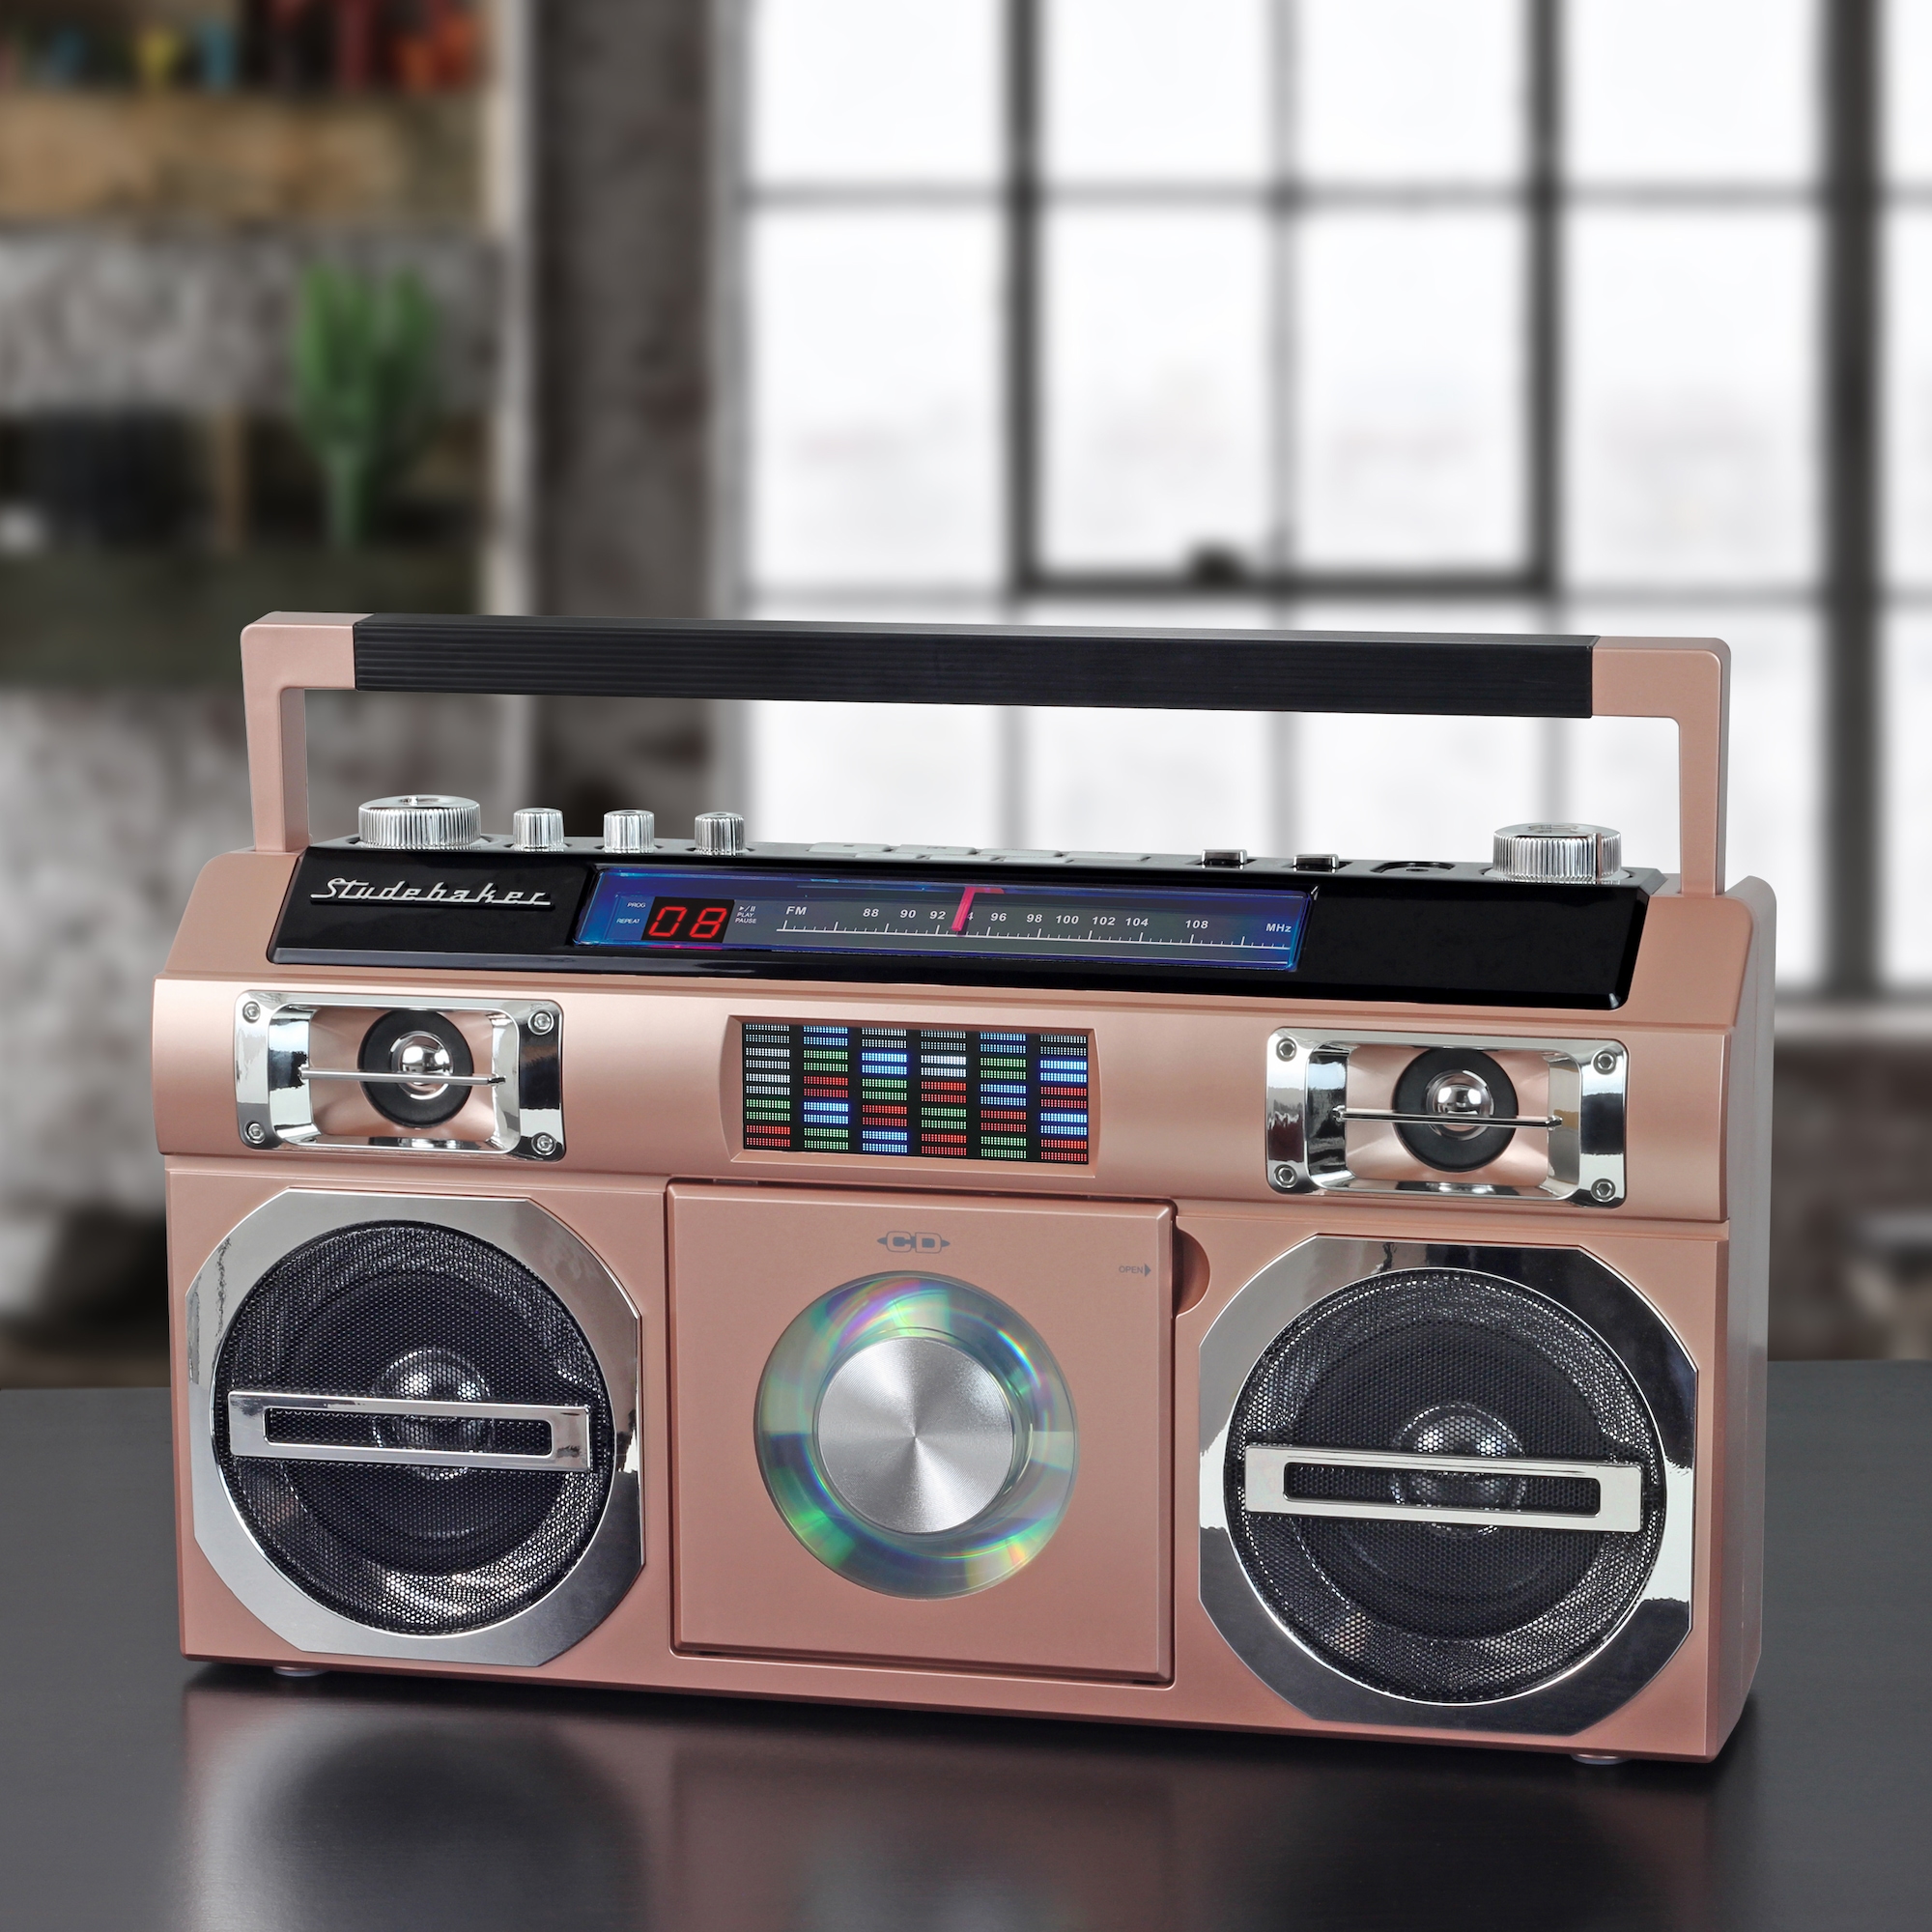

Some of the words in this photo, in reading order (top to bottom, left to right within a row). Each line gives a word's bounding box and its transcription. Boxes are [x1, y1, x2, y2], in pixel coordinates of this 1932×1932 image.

[310, 877, 552, 906] Studebaker
[648, 906, 727, 939] 08
[785, 906, 808, 916] FM
[863, 908, 880, 918] 88
[899, 909, 917, 919] 90
[929, 910, 947, 921] 92
[990, 912, 1008, 923] 96
[1026, 914, 1043, 923] 98
[1055, 915, 1080, 924] 100
[1092, 916, 1117, 926] 102
[1124, 917, 1150, 927] 104
[1185, 920, 1209, 929] 108
[1265, 923, 1293, 933] MHz
[886, 1231, 943, 1254] CD
[1119, 1265, 1144, 1274] OPEN
